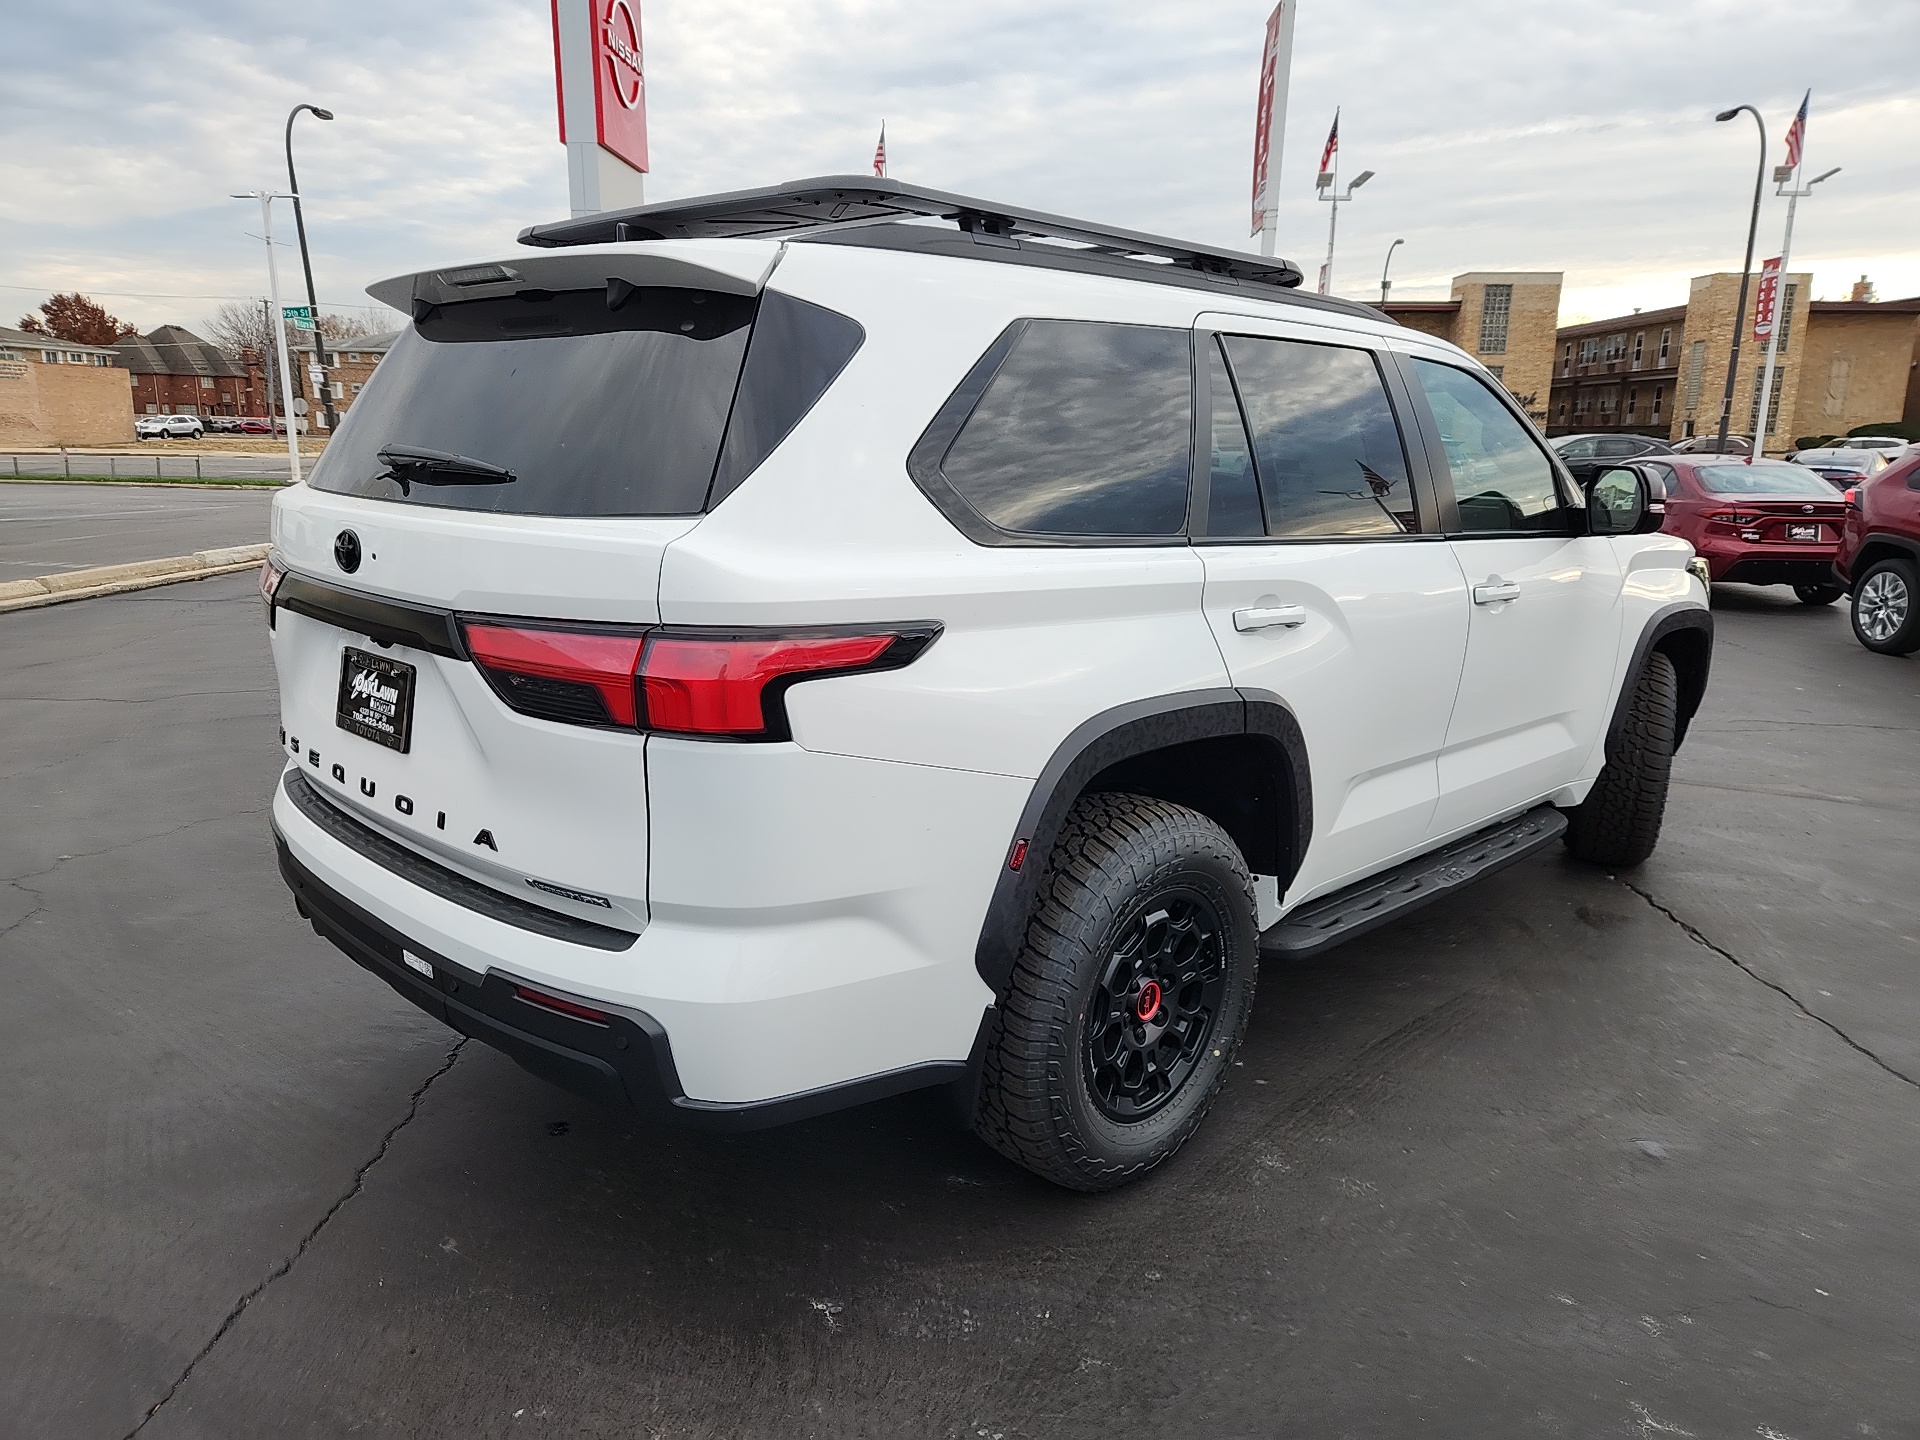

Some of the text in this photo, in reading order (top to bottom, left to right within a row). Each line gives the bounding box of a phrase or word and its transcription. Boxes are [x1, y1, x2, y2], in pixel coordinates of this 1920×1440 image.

[608, 28, 644, 76] NISSAN
[282, 308, 309, 318] 95th St
[1756, 280, 1767, 322] USED
[1767, 278, 1778, 321] CARS
[371, 658, 391, 672] LAWN
[355, 723, 380, 741] TOYOTA
[290, 736, 499, 852] SEQUOIA
